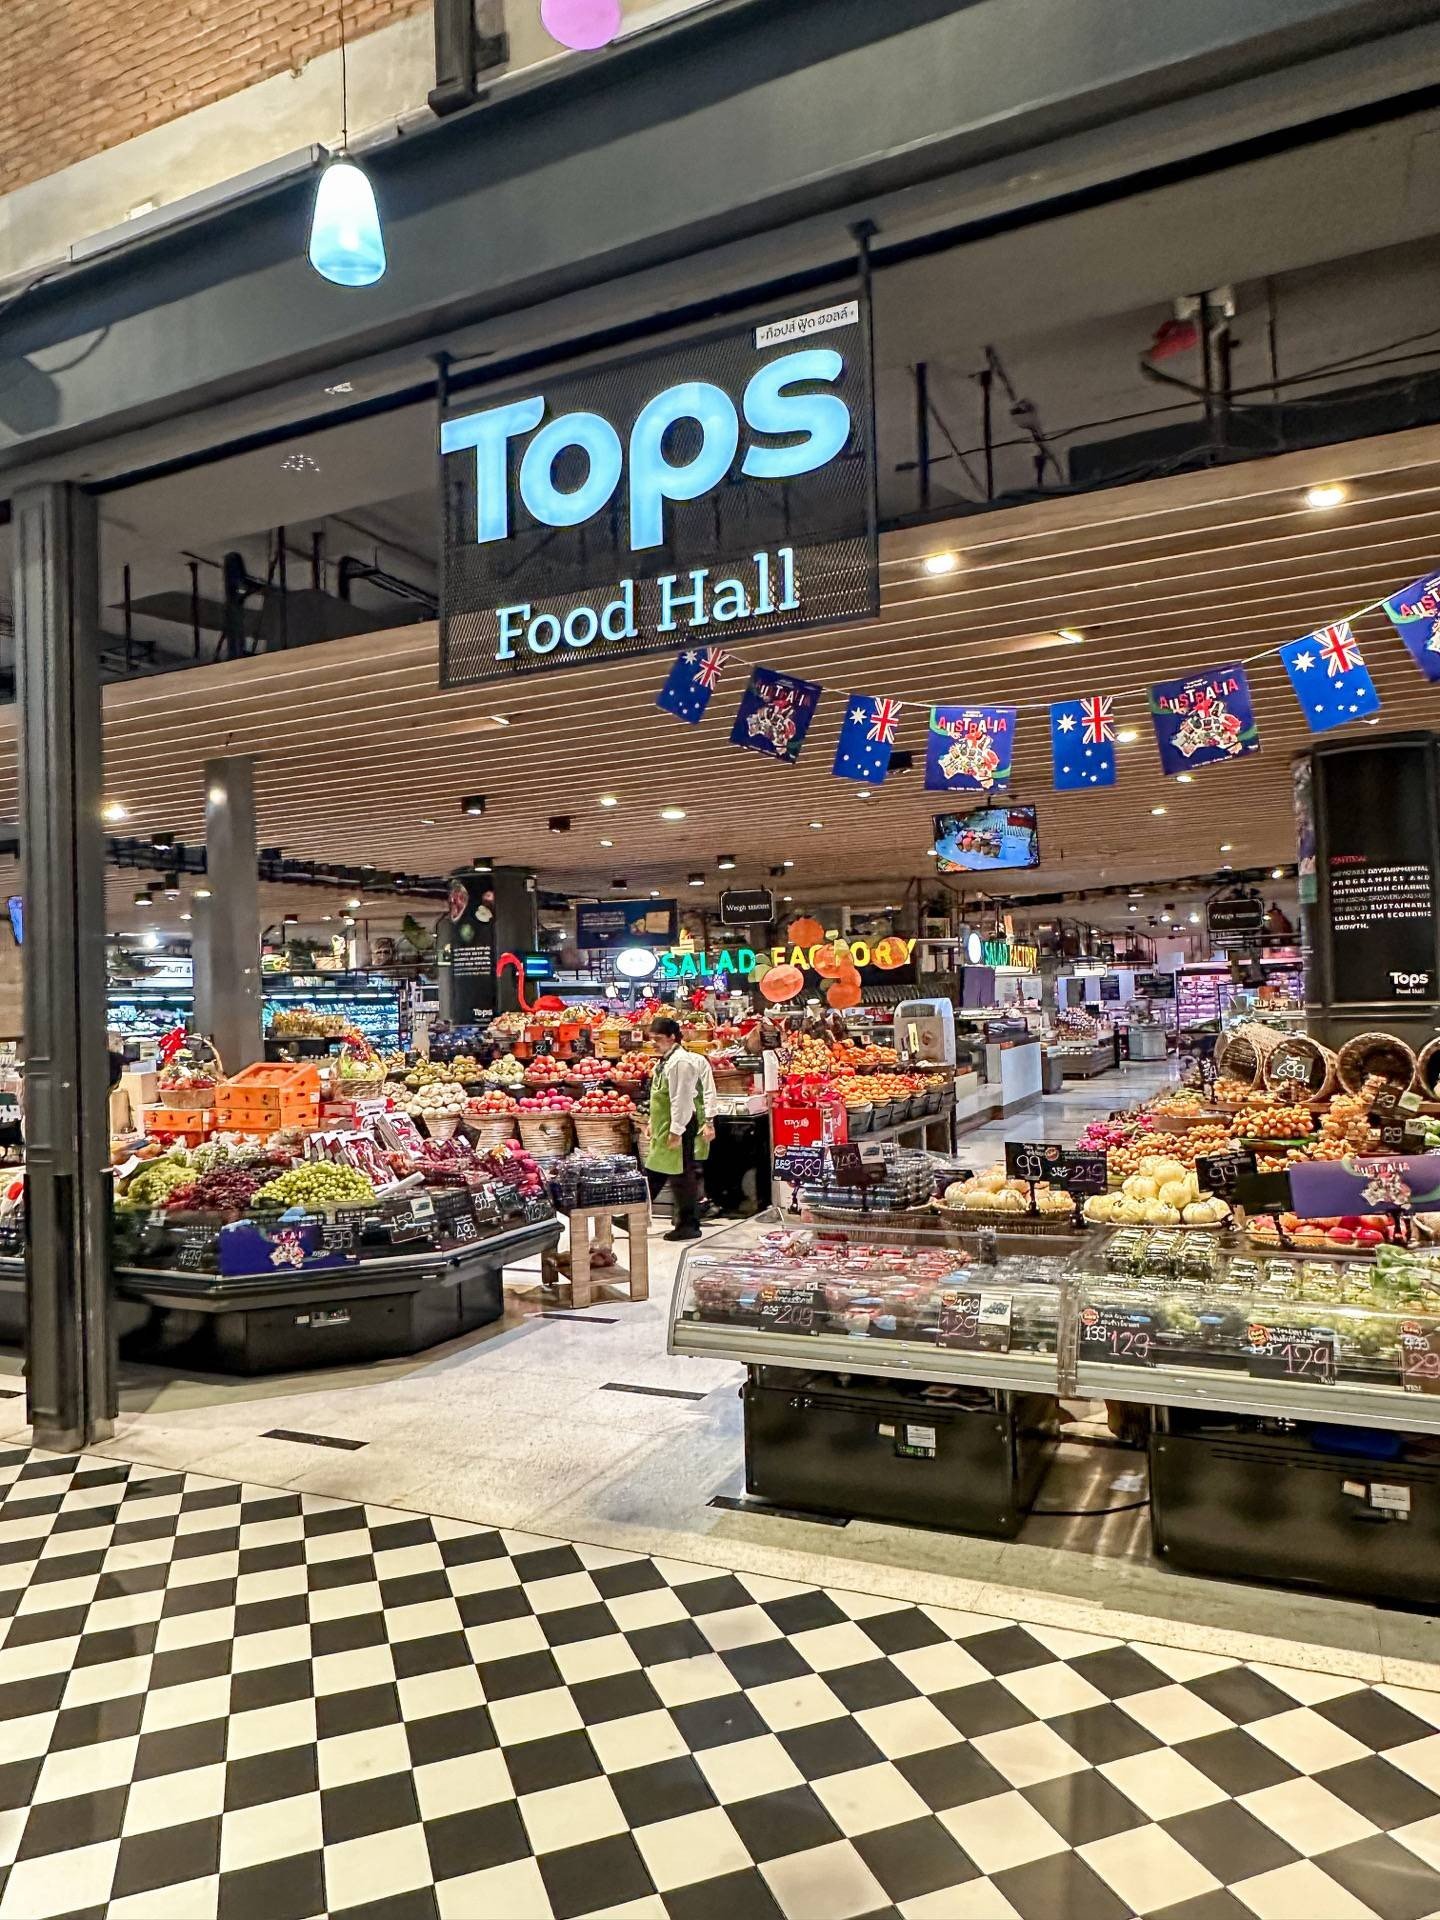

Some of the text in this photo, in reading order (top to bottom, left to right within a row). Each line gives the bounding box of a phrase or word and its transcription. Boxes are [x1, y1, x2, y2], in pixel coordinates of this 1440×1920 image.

[441, 349, 851, 551] Tops
[495, 547, 800, 661] Food Hall
[1400, 587, 1440, 618] AUST
[1159, 677, 1239, 711] AUSTRALIA
[938, 715, 1007, 735] AUSTRALIA
[660, 938, 917, 977] SALAD FACORY
[1389, 971, 1429, 987] Tops
[1277, 1063, 1306, 1080] 699
[790, 1158, 822, 1177] 589
[1016, 1154, 1043, 1178] 99
[774, 1304, 814, 1327] 209
[1108, 1330, 1150, 1358] 129
